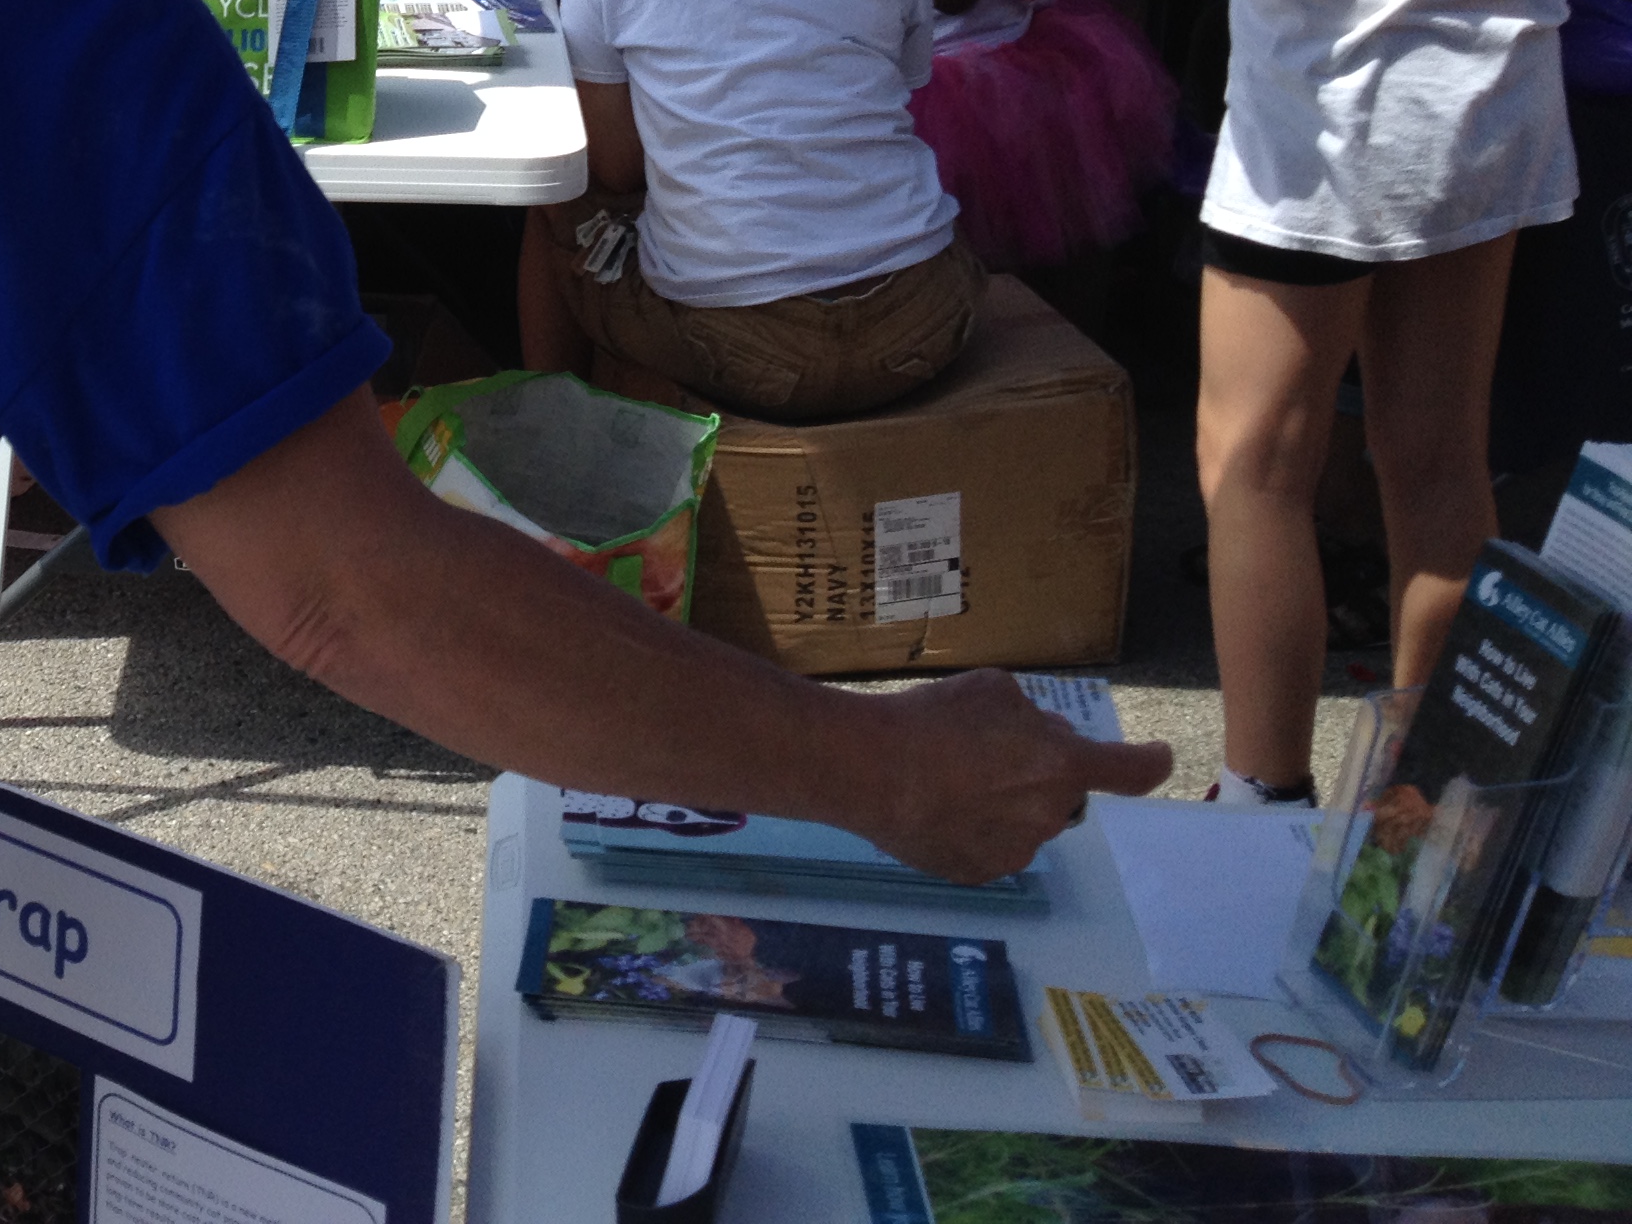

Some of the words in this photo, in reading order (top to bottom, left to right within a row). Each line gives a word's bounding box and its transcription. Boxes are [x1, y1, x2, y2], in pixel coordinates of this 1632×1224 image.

[795, 485, 817, 623] Y2KH131015
[826, 563, 848, 622] NAVY
[109, 1110, 135, 1130] What
